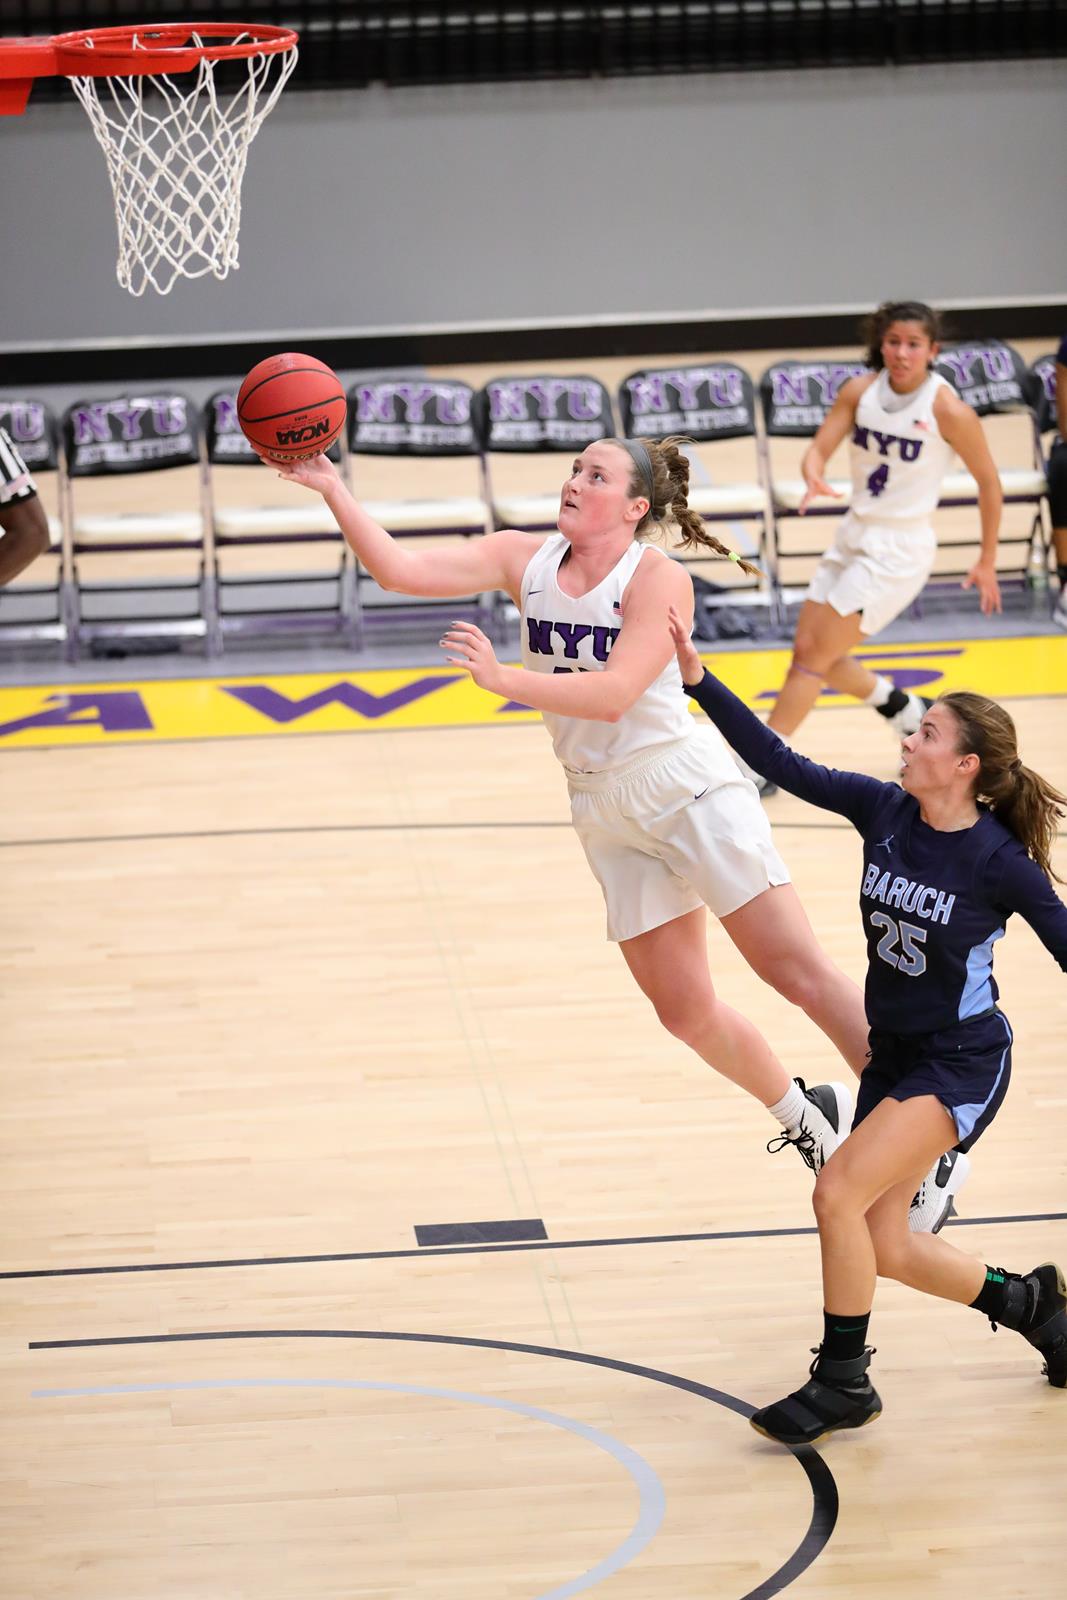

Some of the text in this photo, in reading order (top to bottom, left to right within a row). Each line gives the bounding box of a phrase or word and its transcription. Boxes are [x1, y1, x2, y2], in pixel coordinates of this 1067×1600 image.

[356, 383, 472, 424] NYU
[487, 380, 603, 421] NYU
[627, 368, 743, 415] NYU
[769, 365, 870, 406] NY
[71, 397, 188, 445] NYU
[276, 418, 330, 446] NCAA
[853, 424, 923, 462] NYU
[868, 464, 888, 497] 4
[527, 617, 621, 662] NYU
[862, 863, 956, 926] BARUCH
[869, 911, 928, 977] 25
